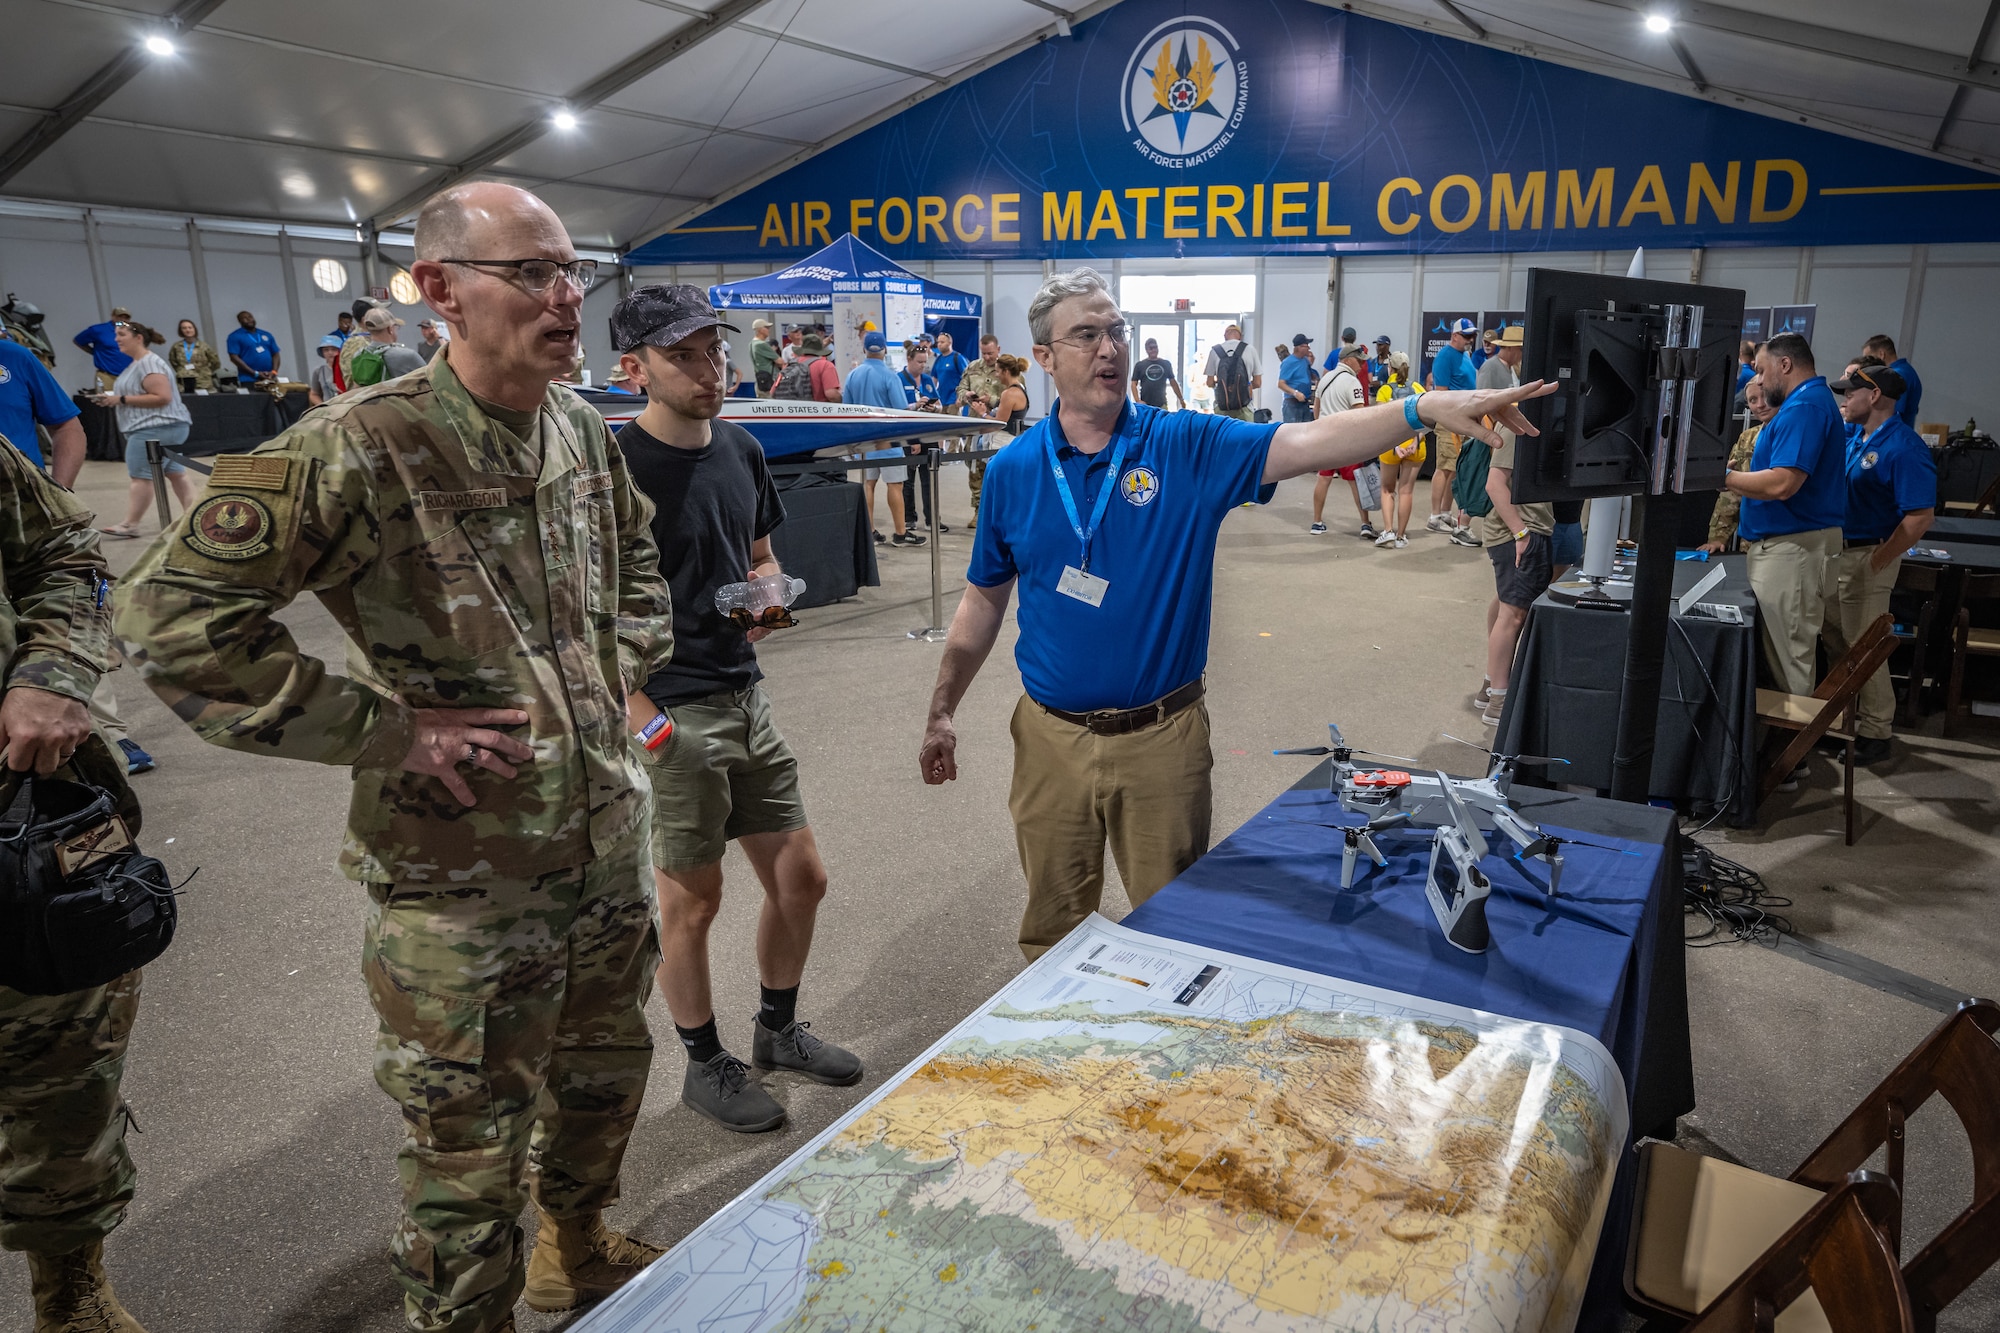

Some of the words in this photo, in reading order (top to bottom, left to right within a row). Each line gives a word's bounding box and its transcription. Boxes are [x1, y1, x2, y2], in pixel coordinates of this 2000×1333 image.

[1133, 138, 1150, 157] AIR
[1149, 154, 1184, 169] FORCE
[1185, 131, 1235, 168] MATERIEL
[1230, 61, 1249, 130] COMMAND
[758, 201, 833, 248] AIR
[850, 193, 1021, 245] FORCE
[1042, 182, 1351, 241] MATERIEL
[1377, 159, 1809, 235] COMMAND
[777, 271, 832, 282] MARATHO
[784, 267, 806, 275] AIR
[805, 265, 848, 278] FORCE
[832, 281, 860, 291] COURSE
[861, 281, 880, 291] MAPS
[885, 281, 907, 293] COURSE
[907, 283, 922, 293] MAPS
[740, 293, 831, 305] USAFMARATHON.COM
[923, 298, 961, 311] ATHON.COM
[751, 405, 784, 414] UNITED
[788, 405, 819, 414] STATES
[822, 405, 834, 414] OF
[837, 406, 873, 415] AMERICA
[424, 491, 503, 510] RICHARDSON
